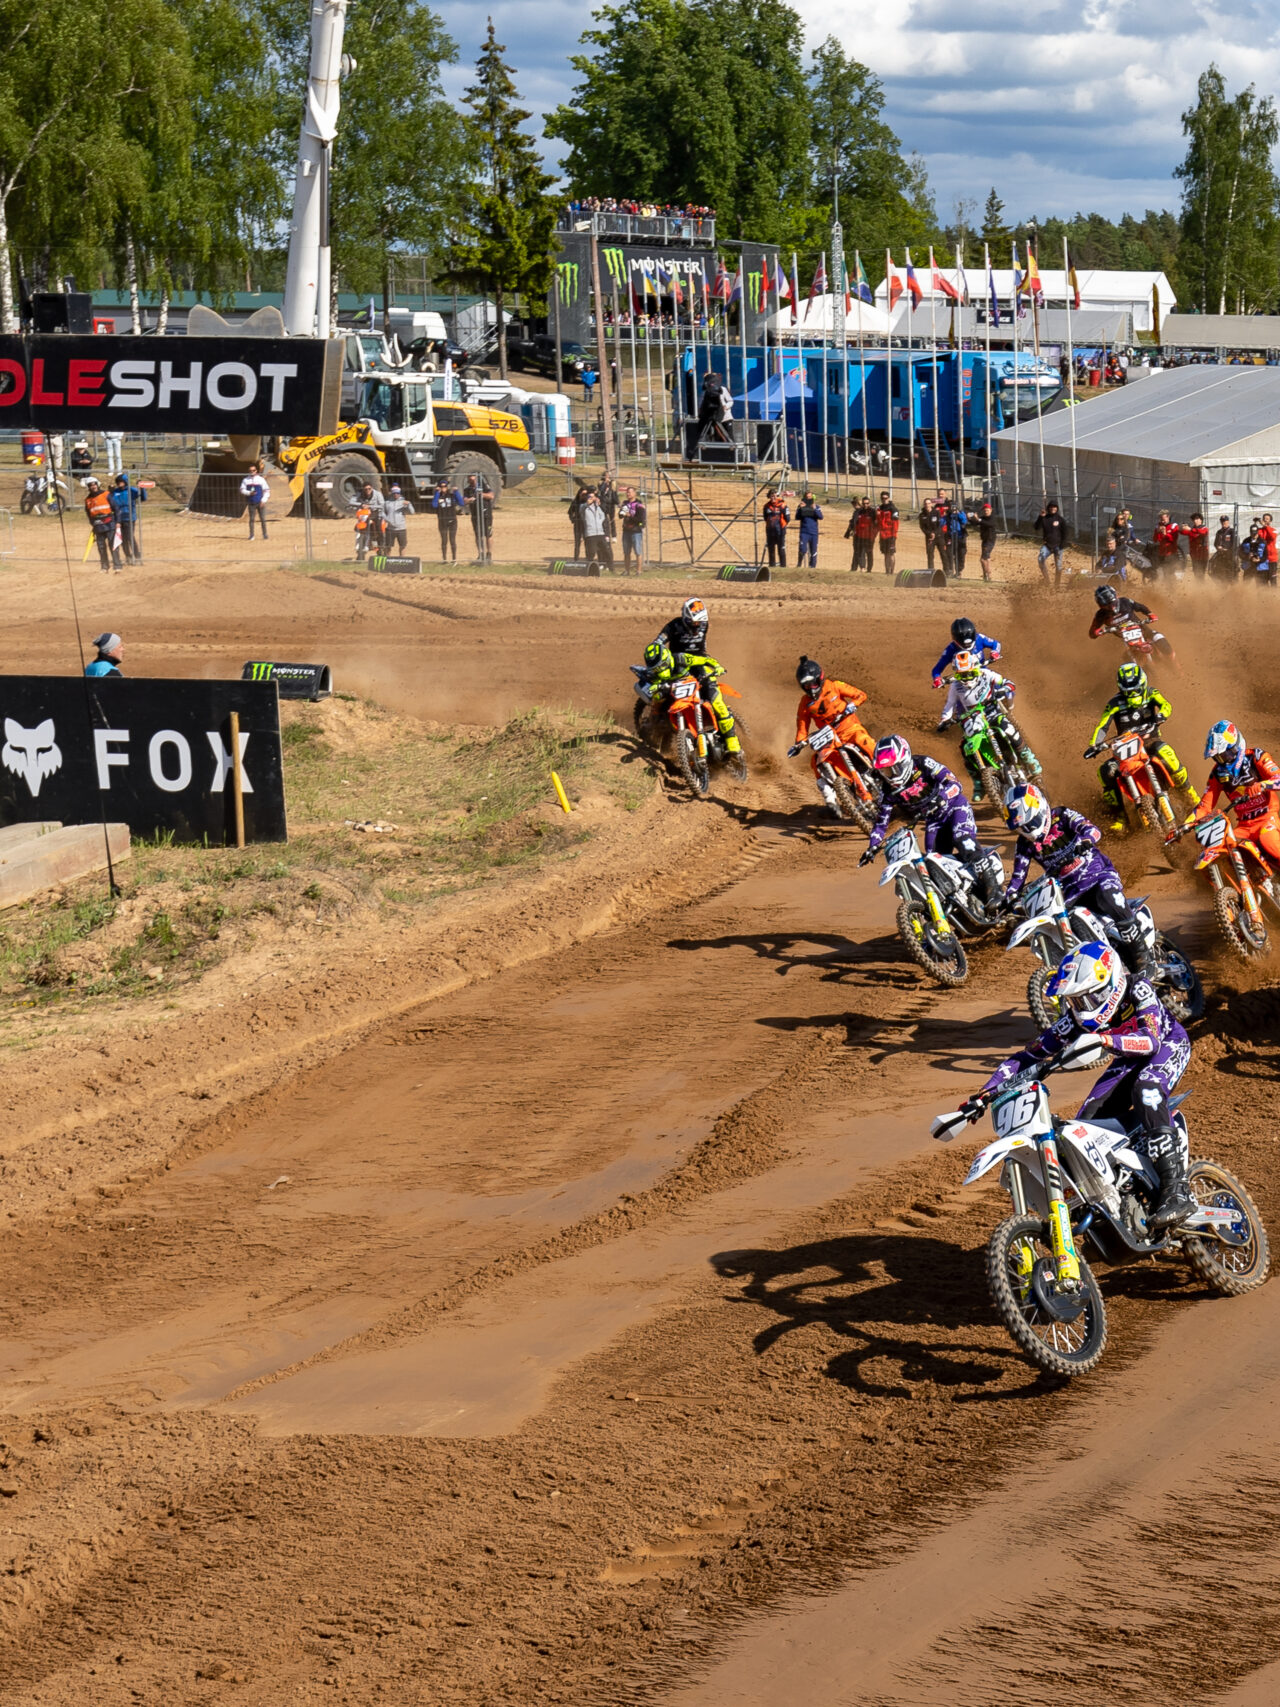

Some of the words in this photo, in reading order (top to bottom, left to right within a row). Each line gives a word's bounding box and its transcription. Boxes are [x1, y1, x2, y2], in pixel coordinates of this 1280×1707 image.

[631, 257, 702, 275] MONSTER
[488, 420, 519, 431] 576
[304, 431, 351, 462] LIEBHERR
[272, 667, 316, 676] MONSTER
[674, 682, 697, 699] 51
[812, 729, 835, 751] 253
[93, 729, 255, 793] FOX
[1197, 818, 1226, 849] 72
[887, 836, 911, 864] 39
[1024, 883, 1053, 918] 74
[997, 1091, 1037, 1138] 96
